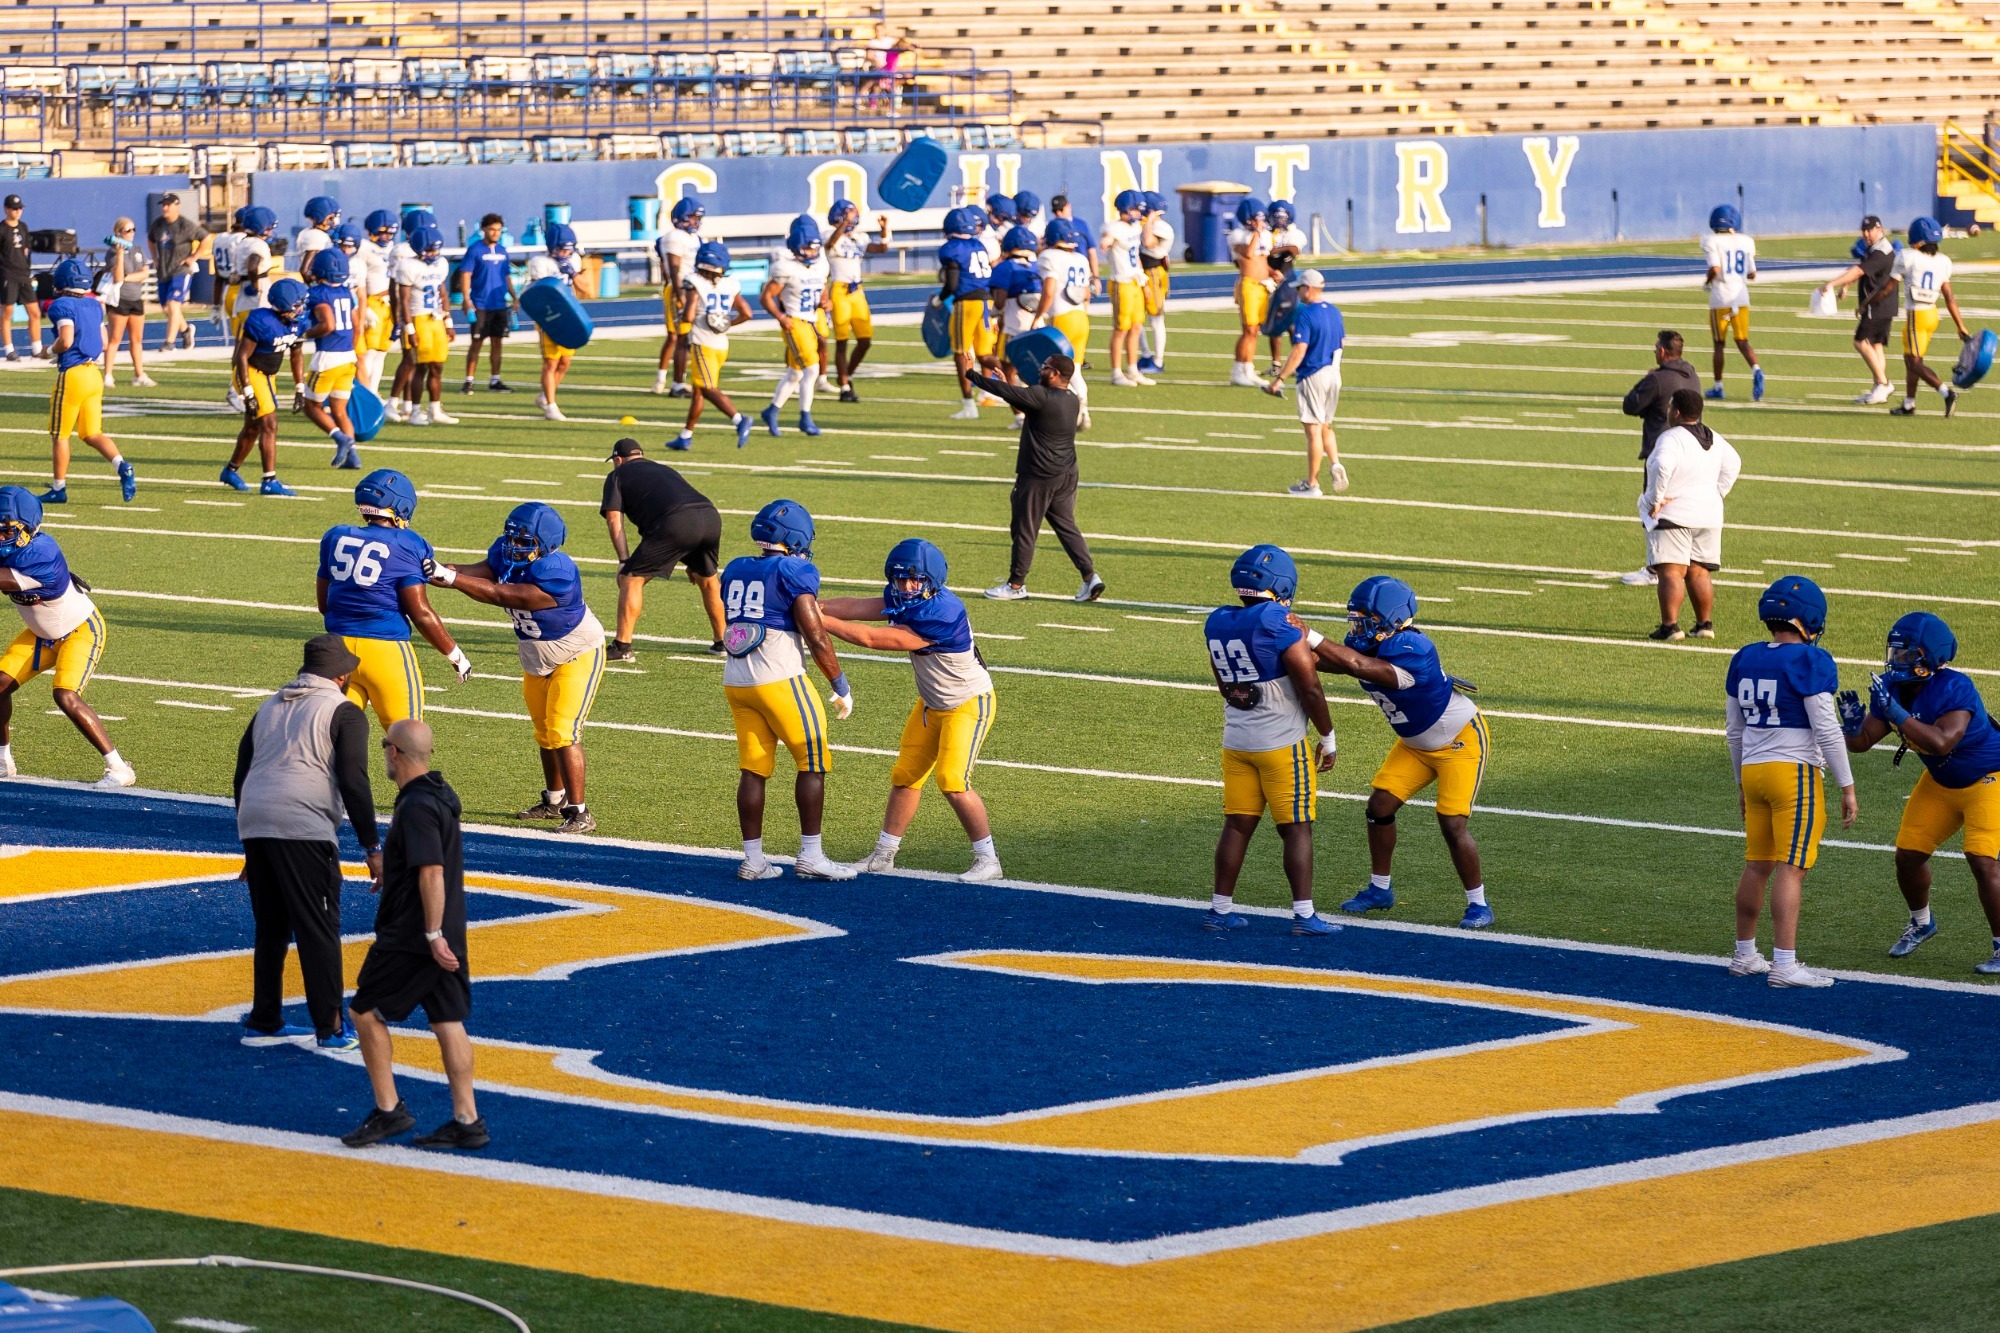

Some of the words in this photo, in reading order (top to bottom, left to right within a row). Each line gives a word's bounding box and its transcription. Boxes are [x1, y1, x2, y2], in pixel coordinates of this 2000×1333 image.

[1726, 250, 1745, 274] 18
[334, 297, 353, 331] 17
[706, 293, 729, 314] 25
[330, 536, 391, 587] 56
[1208, 638, 1260, 683] 93
[1738, 677, 1781, 726] 97
